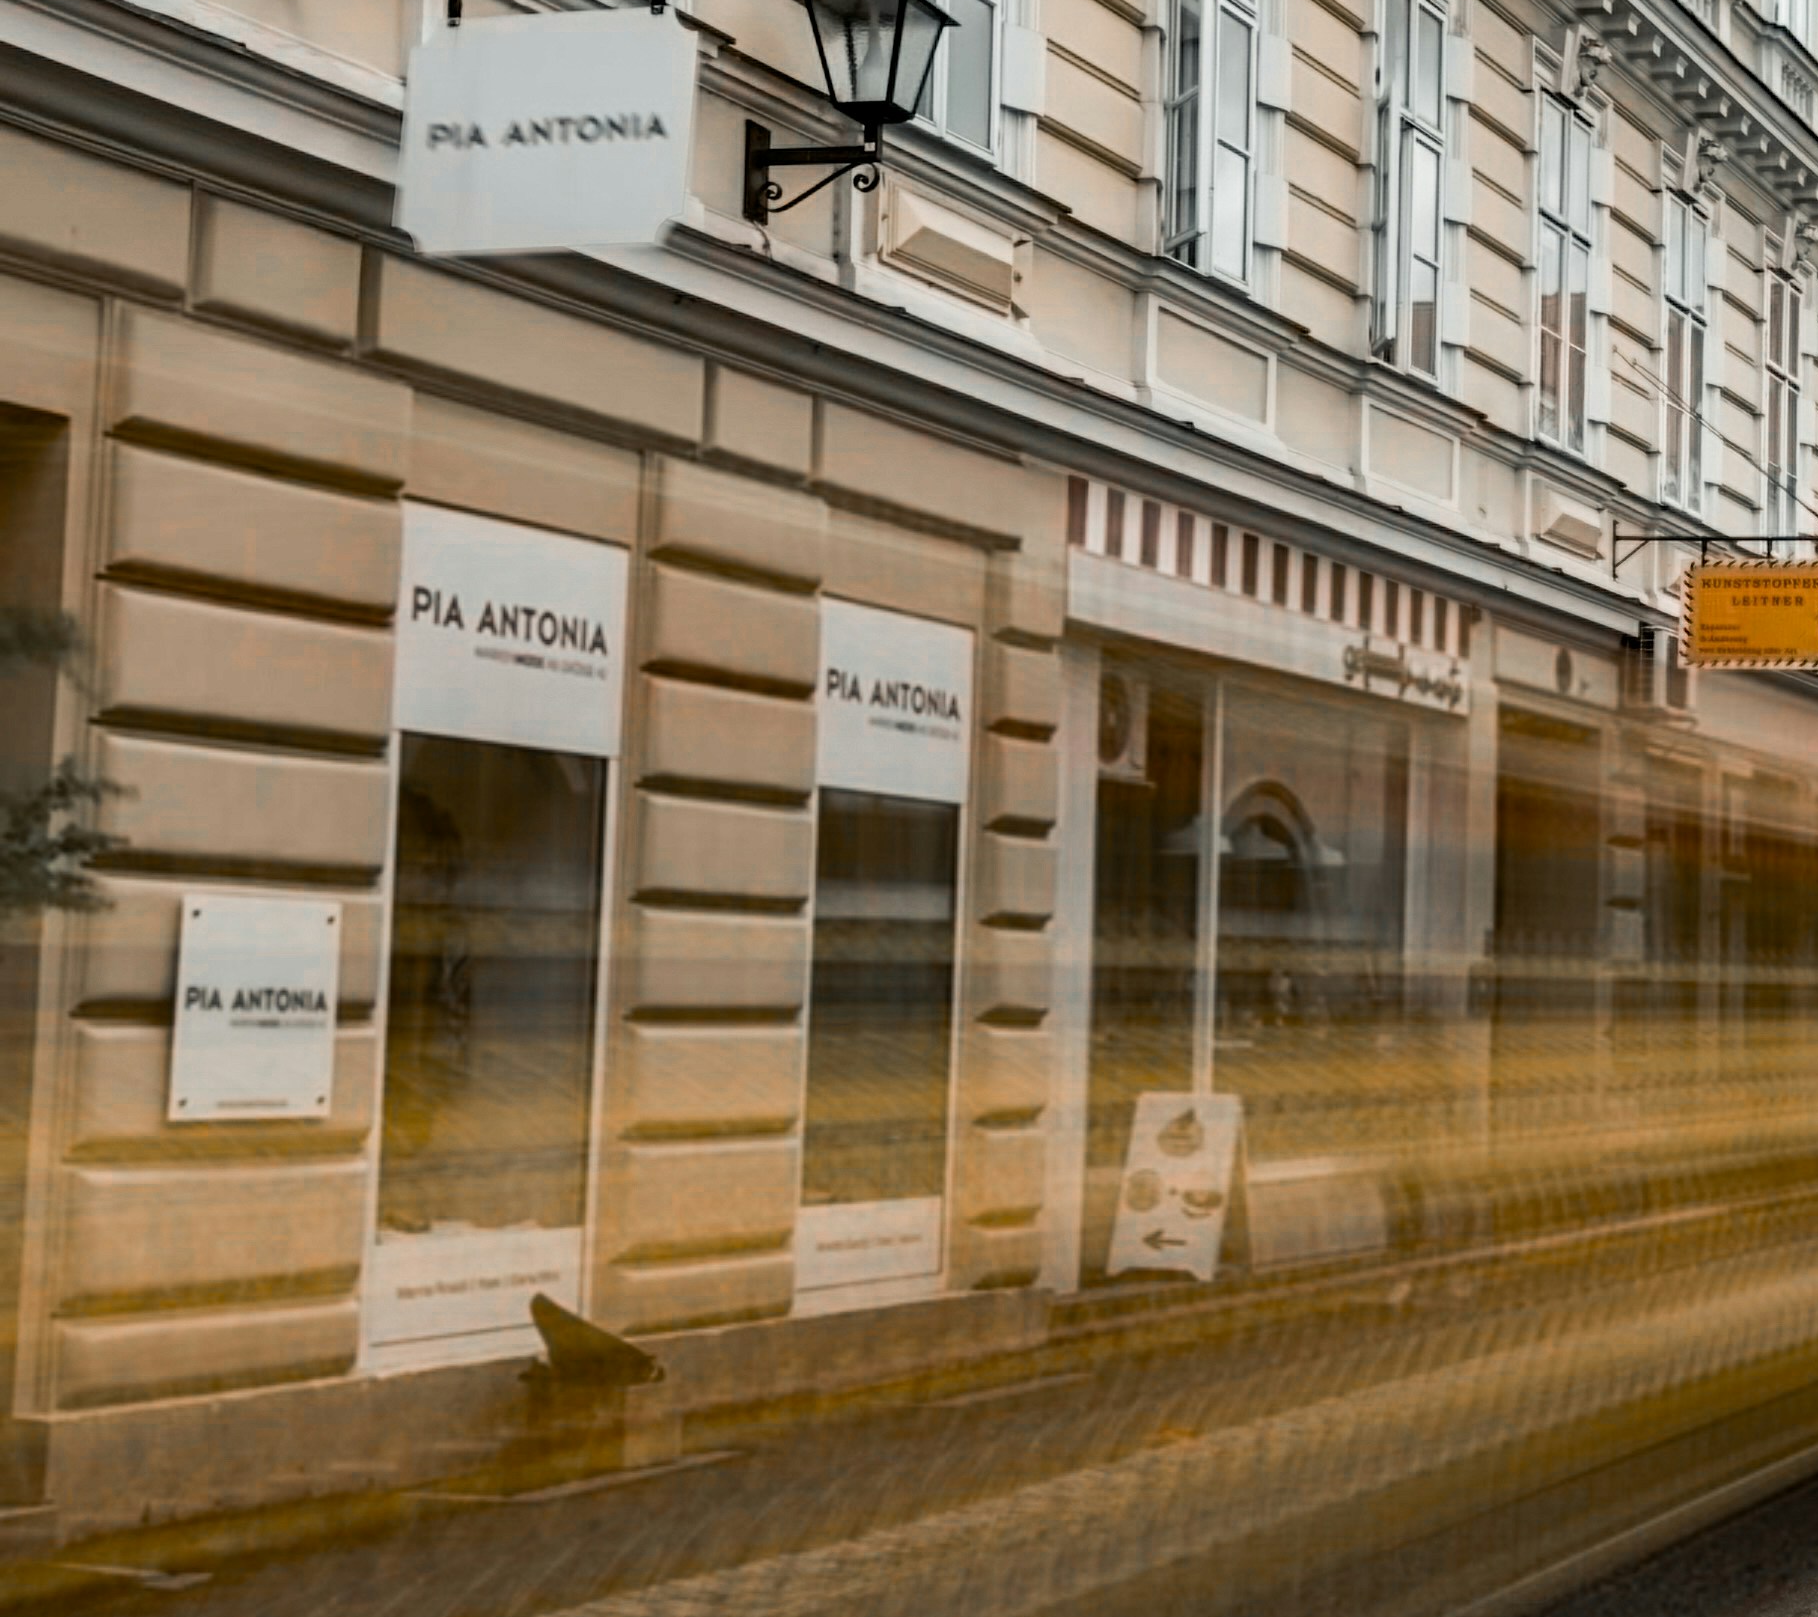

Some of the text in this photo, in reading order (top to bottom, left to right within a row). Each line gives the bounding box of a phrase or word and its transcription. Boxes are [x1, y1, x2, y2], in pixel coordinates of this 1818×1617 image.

[426, 112, 668, 150] PIA ANTONIA
[1732, 595, 1805, 606] LEITNER
[411, 585, 608, 656] PIA ANTONIA
[826, 668, 961, 722] PIA ANTONIA
[184, 986, 329, 1013] PIA ANTONIA
